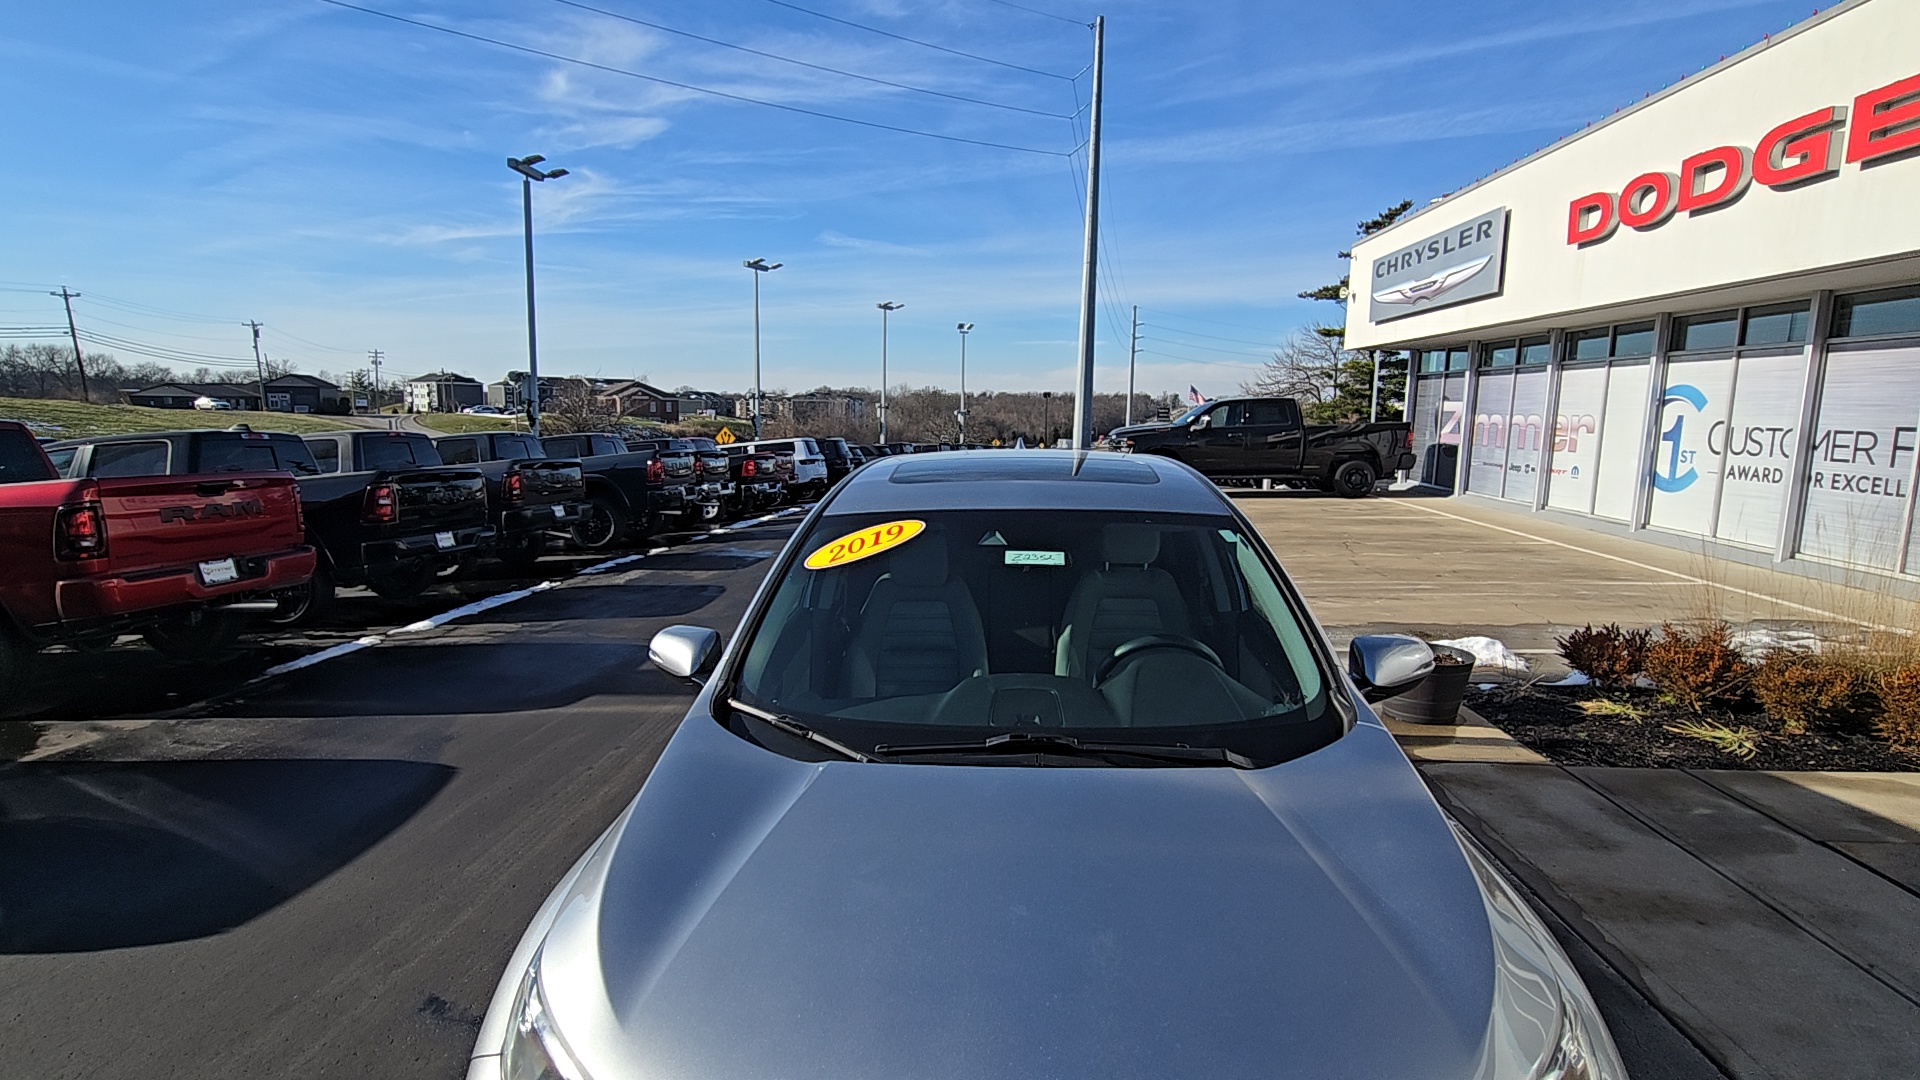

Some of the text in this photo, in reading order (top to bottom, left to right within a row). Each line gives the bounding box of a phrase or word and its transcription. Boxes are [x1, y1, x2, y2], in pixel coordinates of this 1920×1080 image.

[1567, 74, 1920, 245] DODGE
[1376, 220, 1493, 278] CHRYSLER
[1440, 401, 1595, 453] Zmmer
[1726, 464, 1783, 484] AWARD
[1830, 472, 1906, 498] EXCELL
[160, 499, 264, 523] RAM
[829, 524, 905, 563] 2019
